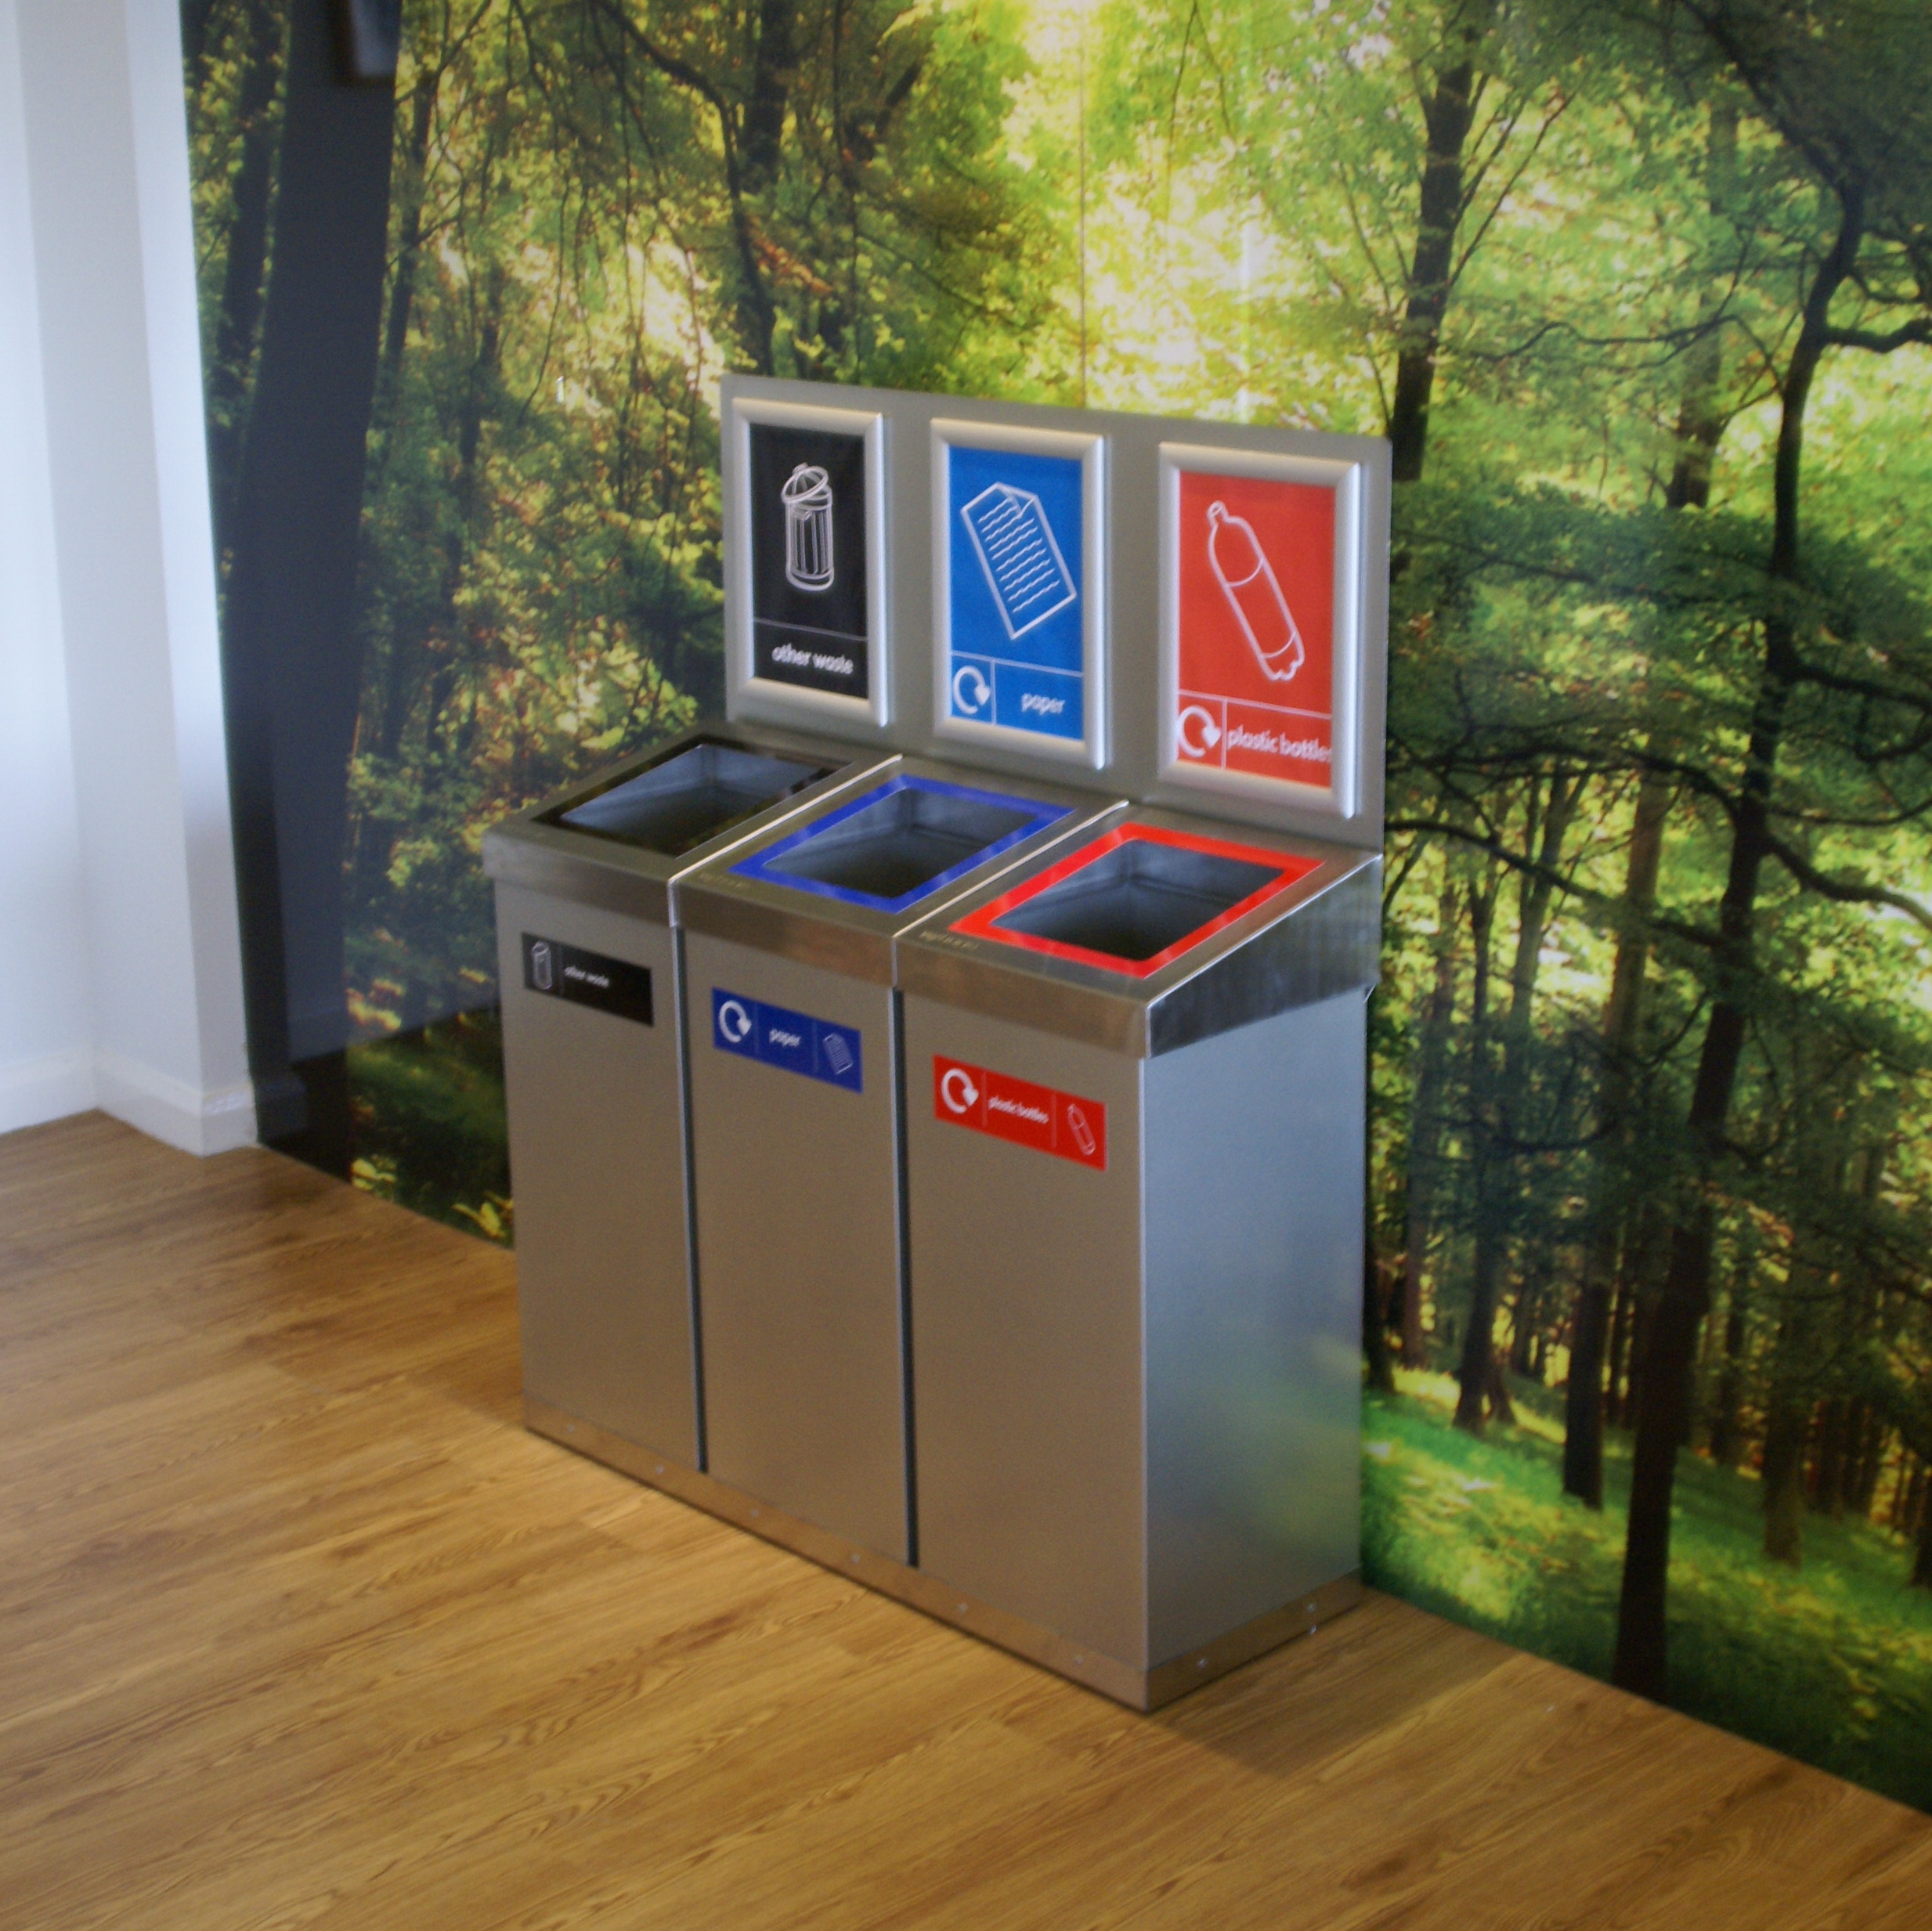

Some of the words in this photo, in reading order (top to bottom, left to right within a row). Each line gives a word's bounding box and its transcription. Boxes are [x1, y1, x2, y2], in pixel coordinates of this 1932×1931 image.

[771, 643, 811, 666] other
[812, 653, 854, 674] waste
[1021, 692, 1065, 716] paper
[1227, 724, 1278, 753] plastic
[769, 1028, 801, 1047] paper
[988, 1095, 1017, 1114] plastic
[1017, 1102, 1049, 1124] bottles
